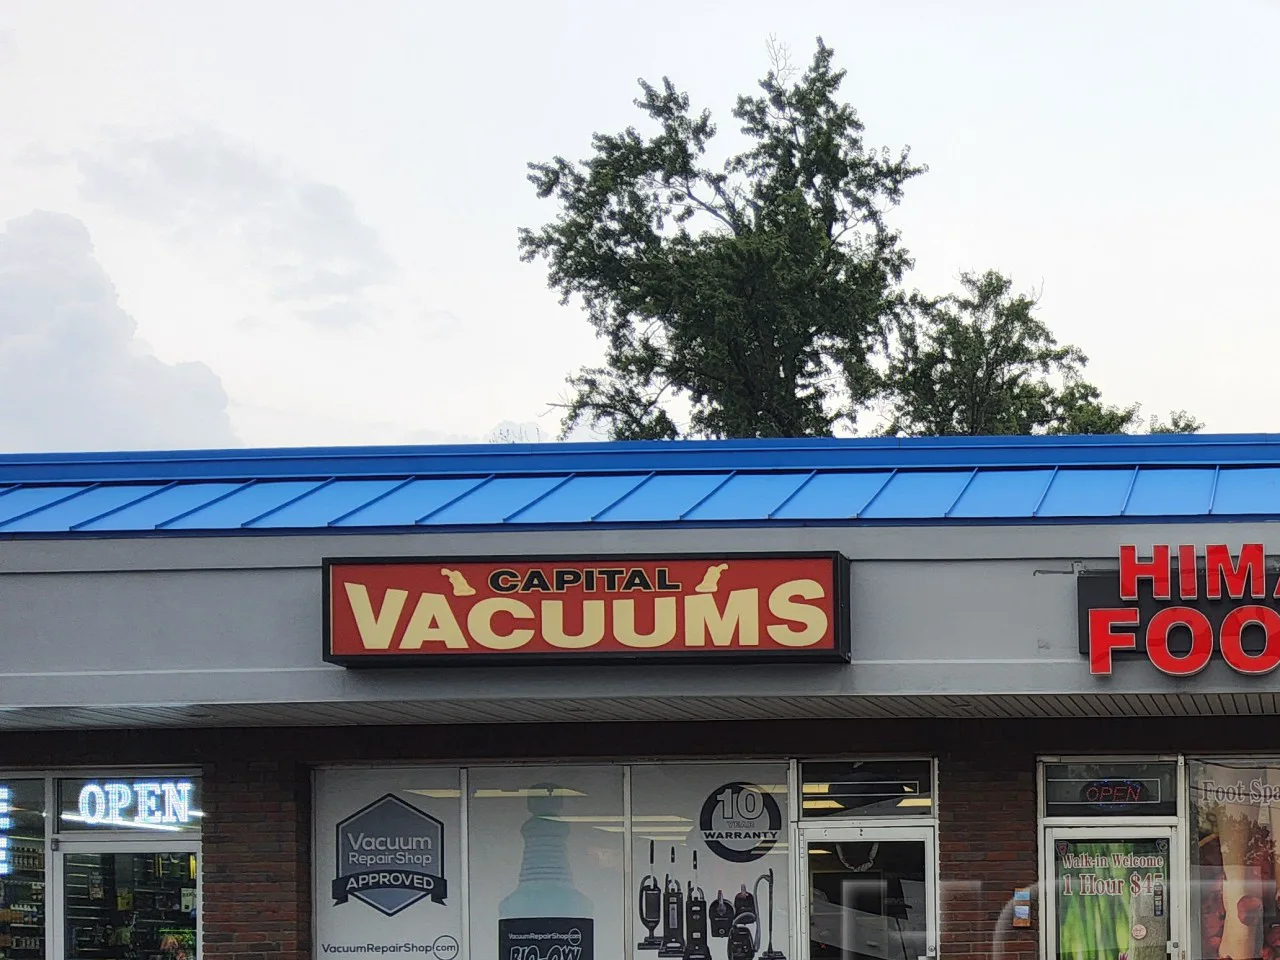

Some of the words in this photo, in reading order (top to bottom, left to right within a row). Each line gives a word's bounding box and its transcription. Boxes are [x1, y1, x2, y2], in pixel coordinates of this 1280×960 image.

[487, 567, 682, 593] CAPITAL
[343, 578, 829, 651] VACUUMS
[1086, 785, 1142, 802] OPEN
[1202, 780, 1245, 802] Foot
[79, 782, 193, 825] OPEN
[716, 788, 764, 820] 10
[726, 820, 755, 829] YEAR
[347, 832, 432, 850] Vacuum
[703, 831, 778, 840] WARRANTY
[1062, 852, 1108, 869] Walk-in
[1111, 852, 1164, 869] Welcome
[346, 872, 434, 891] APPROVED
[1063, 873, 1073, 896] 1
[1079, 873, 1124, 896] Hour
